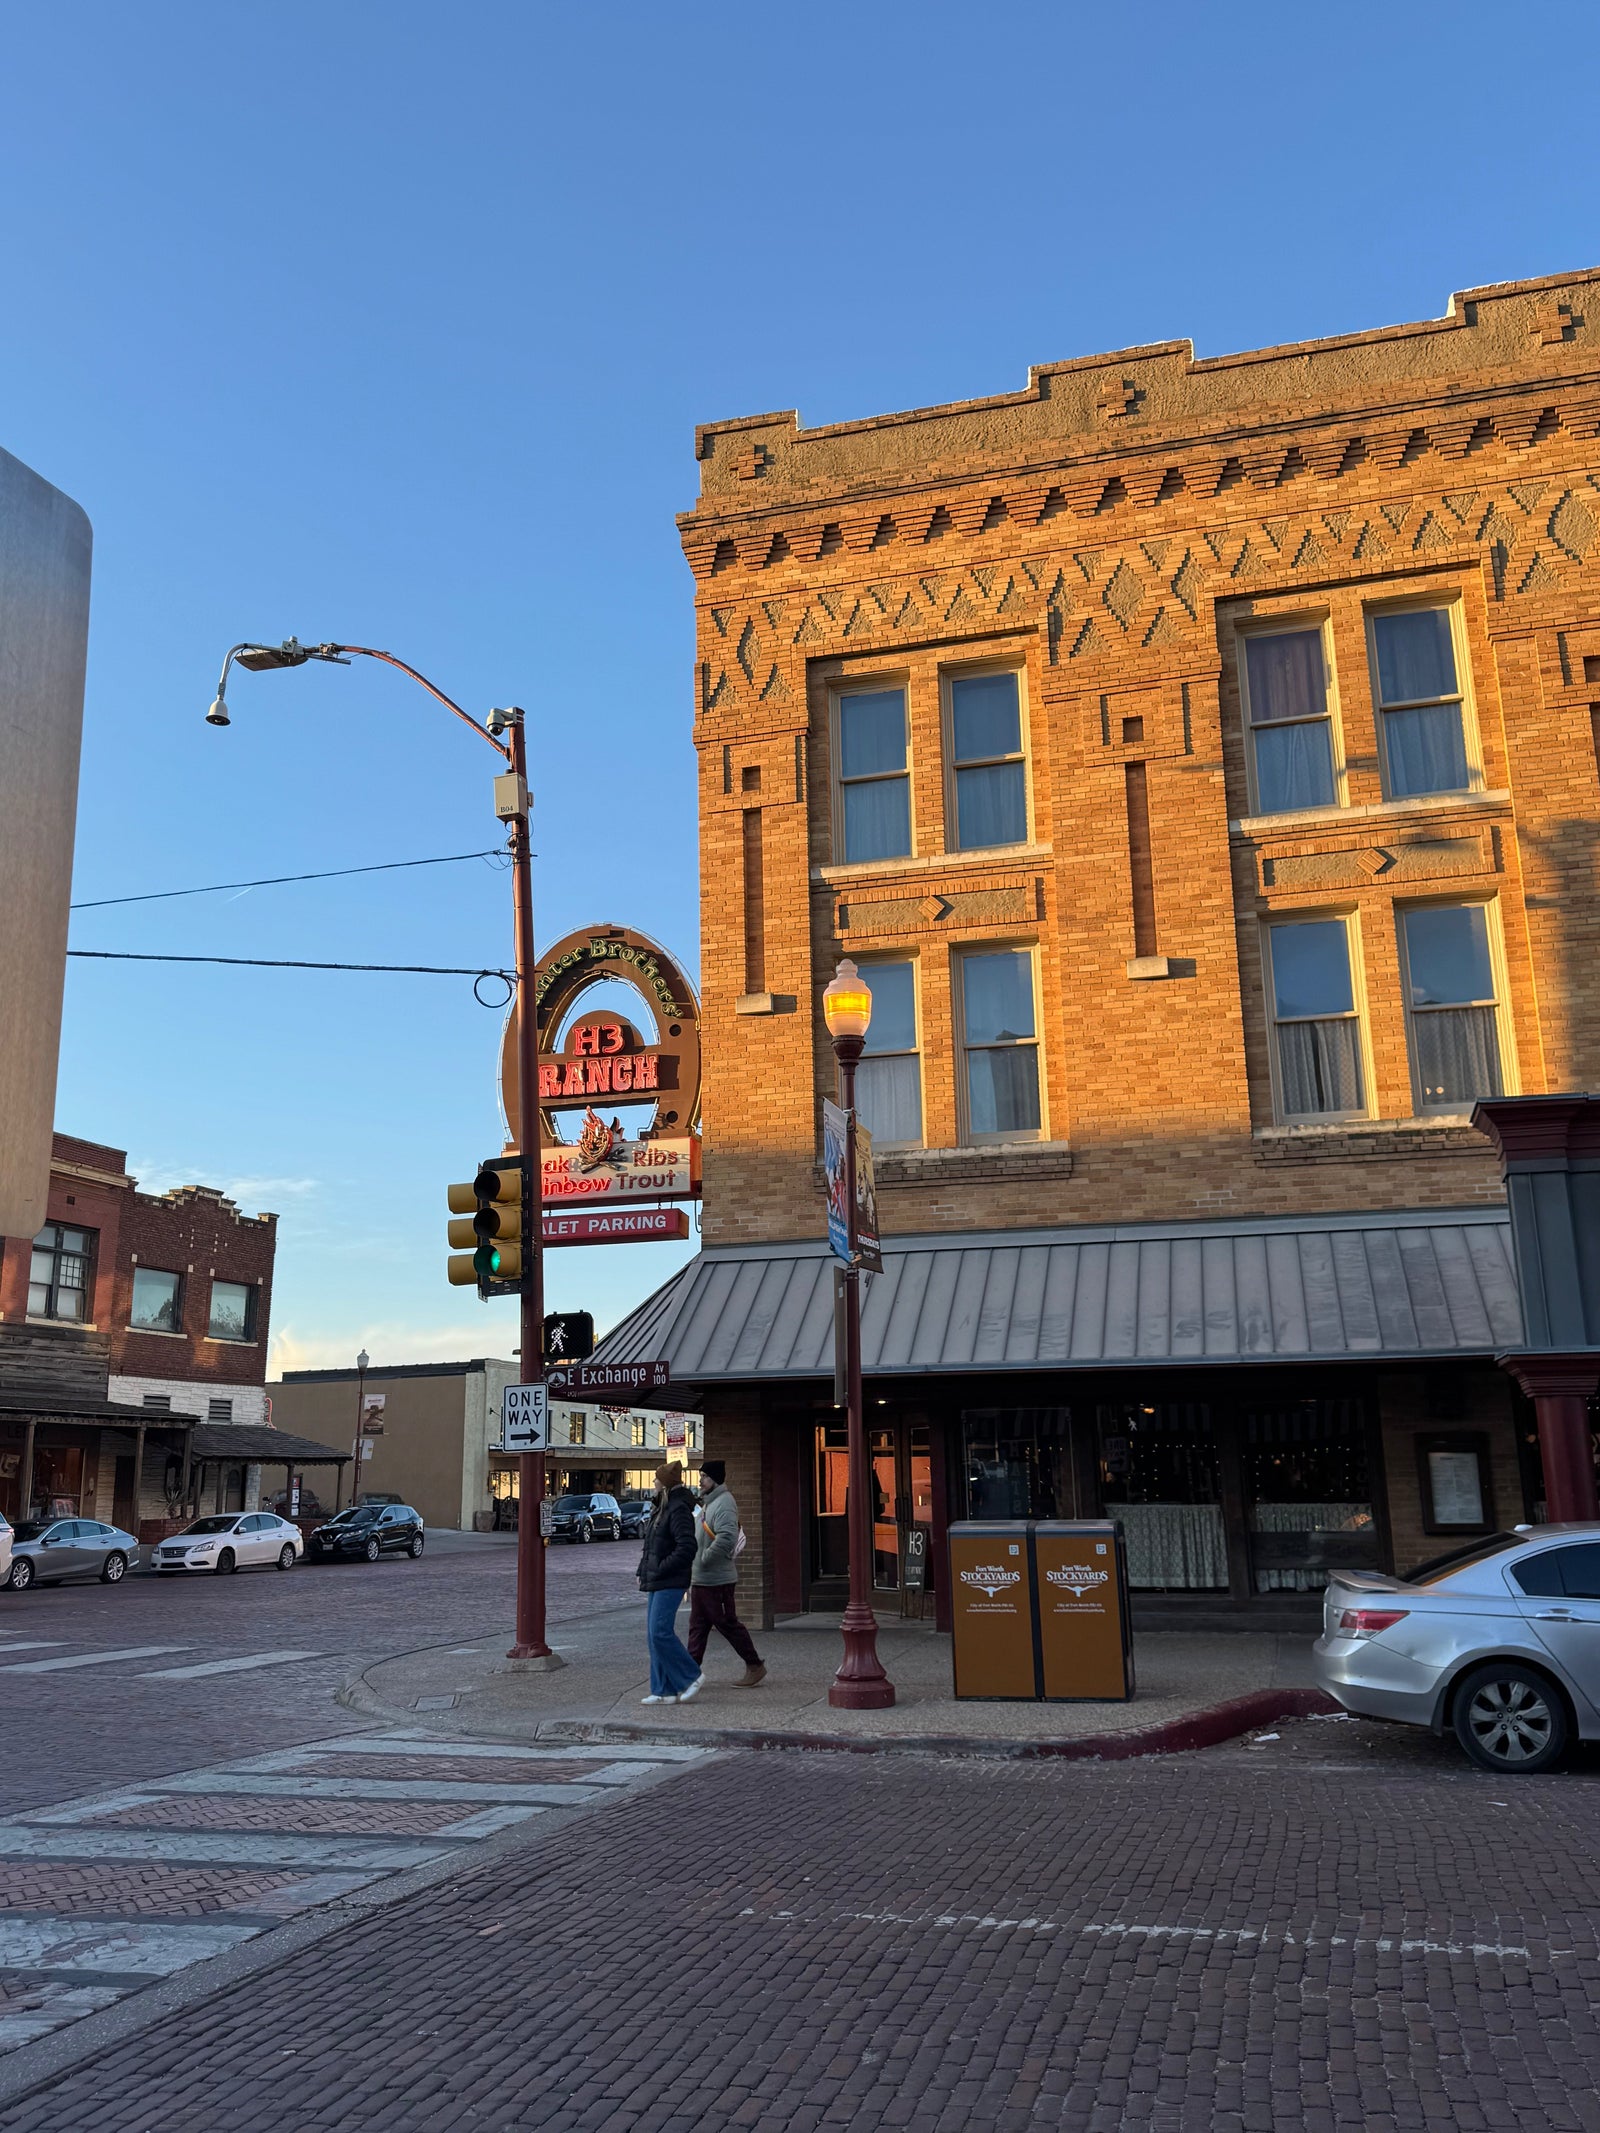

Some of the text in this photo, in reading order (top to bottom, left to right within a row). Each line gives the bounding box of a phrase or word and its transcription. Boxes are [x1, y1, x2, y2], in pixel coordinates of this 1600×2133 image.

[536, 946, 584, 1007] unter
[572, 1023, 624, 1056] H3
[538, 1053, 659, 1098] RANCH
[632, 1148, 679, 1167] Ribs
[616, 1169, 676, 1190] Trout
[542, 1215, 667, 1236] ALET PARKING
[567, 1366, 647, 1387] E Exchange
[654, 1363, 664, 1373] Av
[653, 1374, 667, 1385] 100
[508, 1390, 543, 1408] ONE
[508, 1409, 543, 1426] WAY
[909, 1531, 924, 1556] H3
[960, 1571, 1021, 1582] STOCKYARDS
[1046, 1570, 1109, 1582] STOCKYARDS
